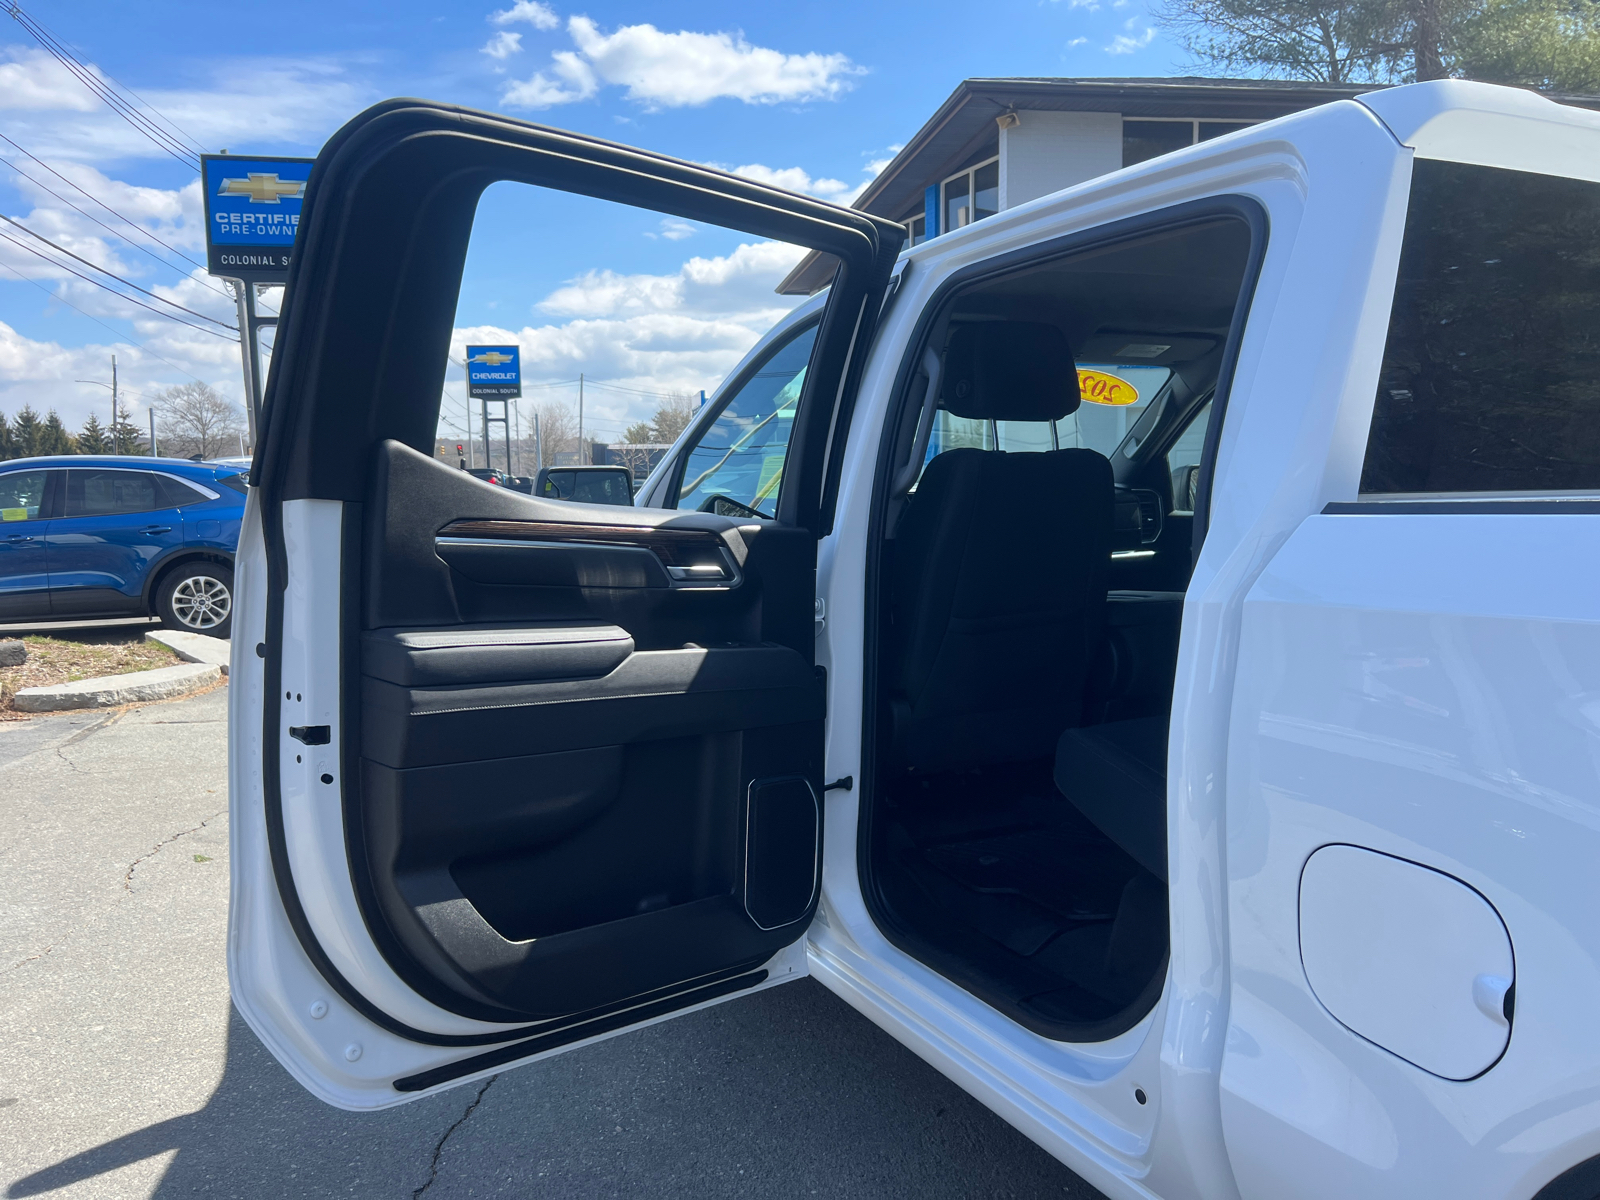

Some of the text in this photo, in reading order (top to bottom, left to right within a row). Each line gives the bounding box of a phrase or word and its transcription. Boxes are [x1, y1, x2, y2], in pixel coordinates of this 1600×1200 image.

[215, 212, 300, 224] CERTIFIE
[221, 224, 297, 235] PRE-OWN
[221, 254, 292, 266] COLONIAL S
[472, 372, 516, 380] CHEVROLET
